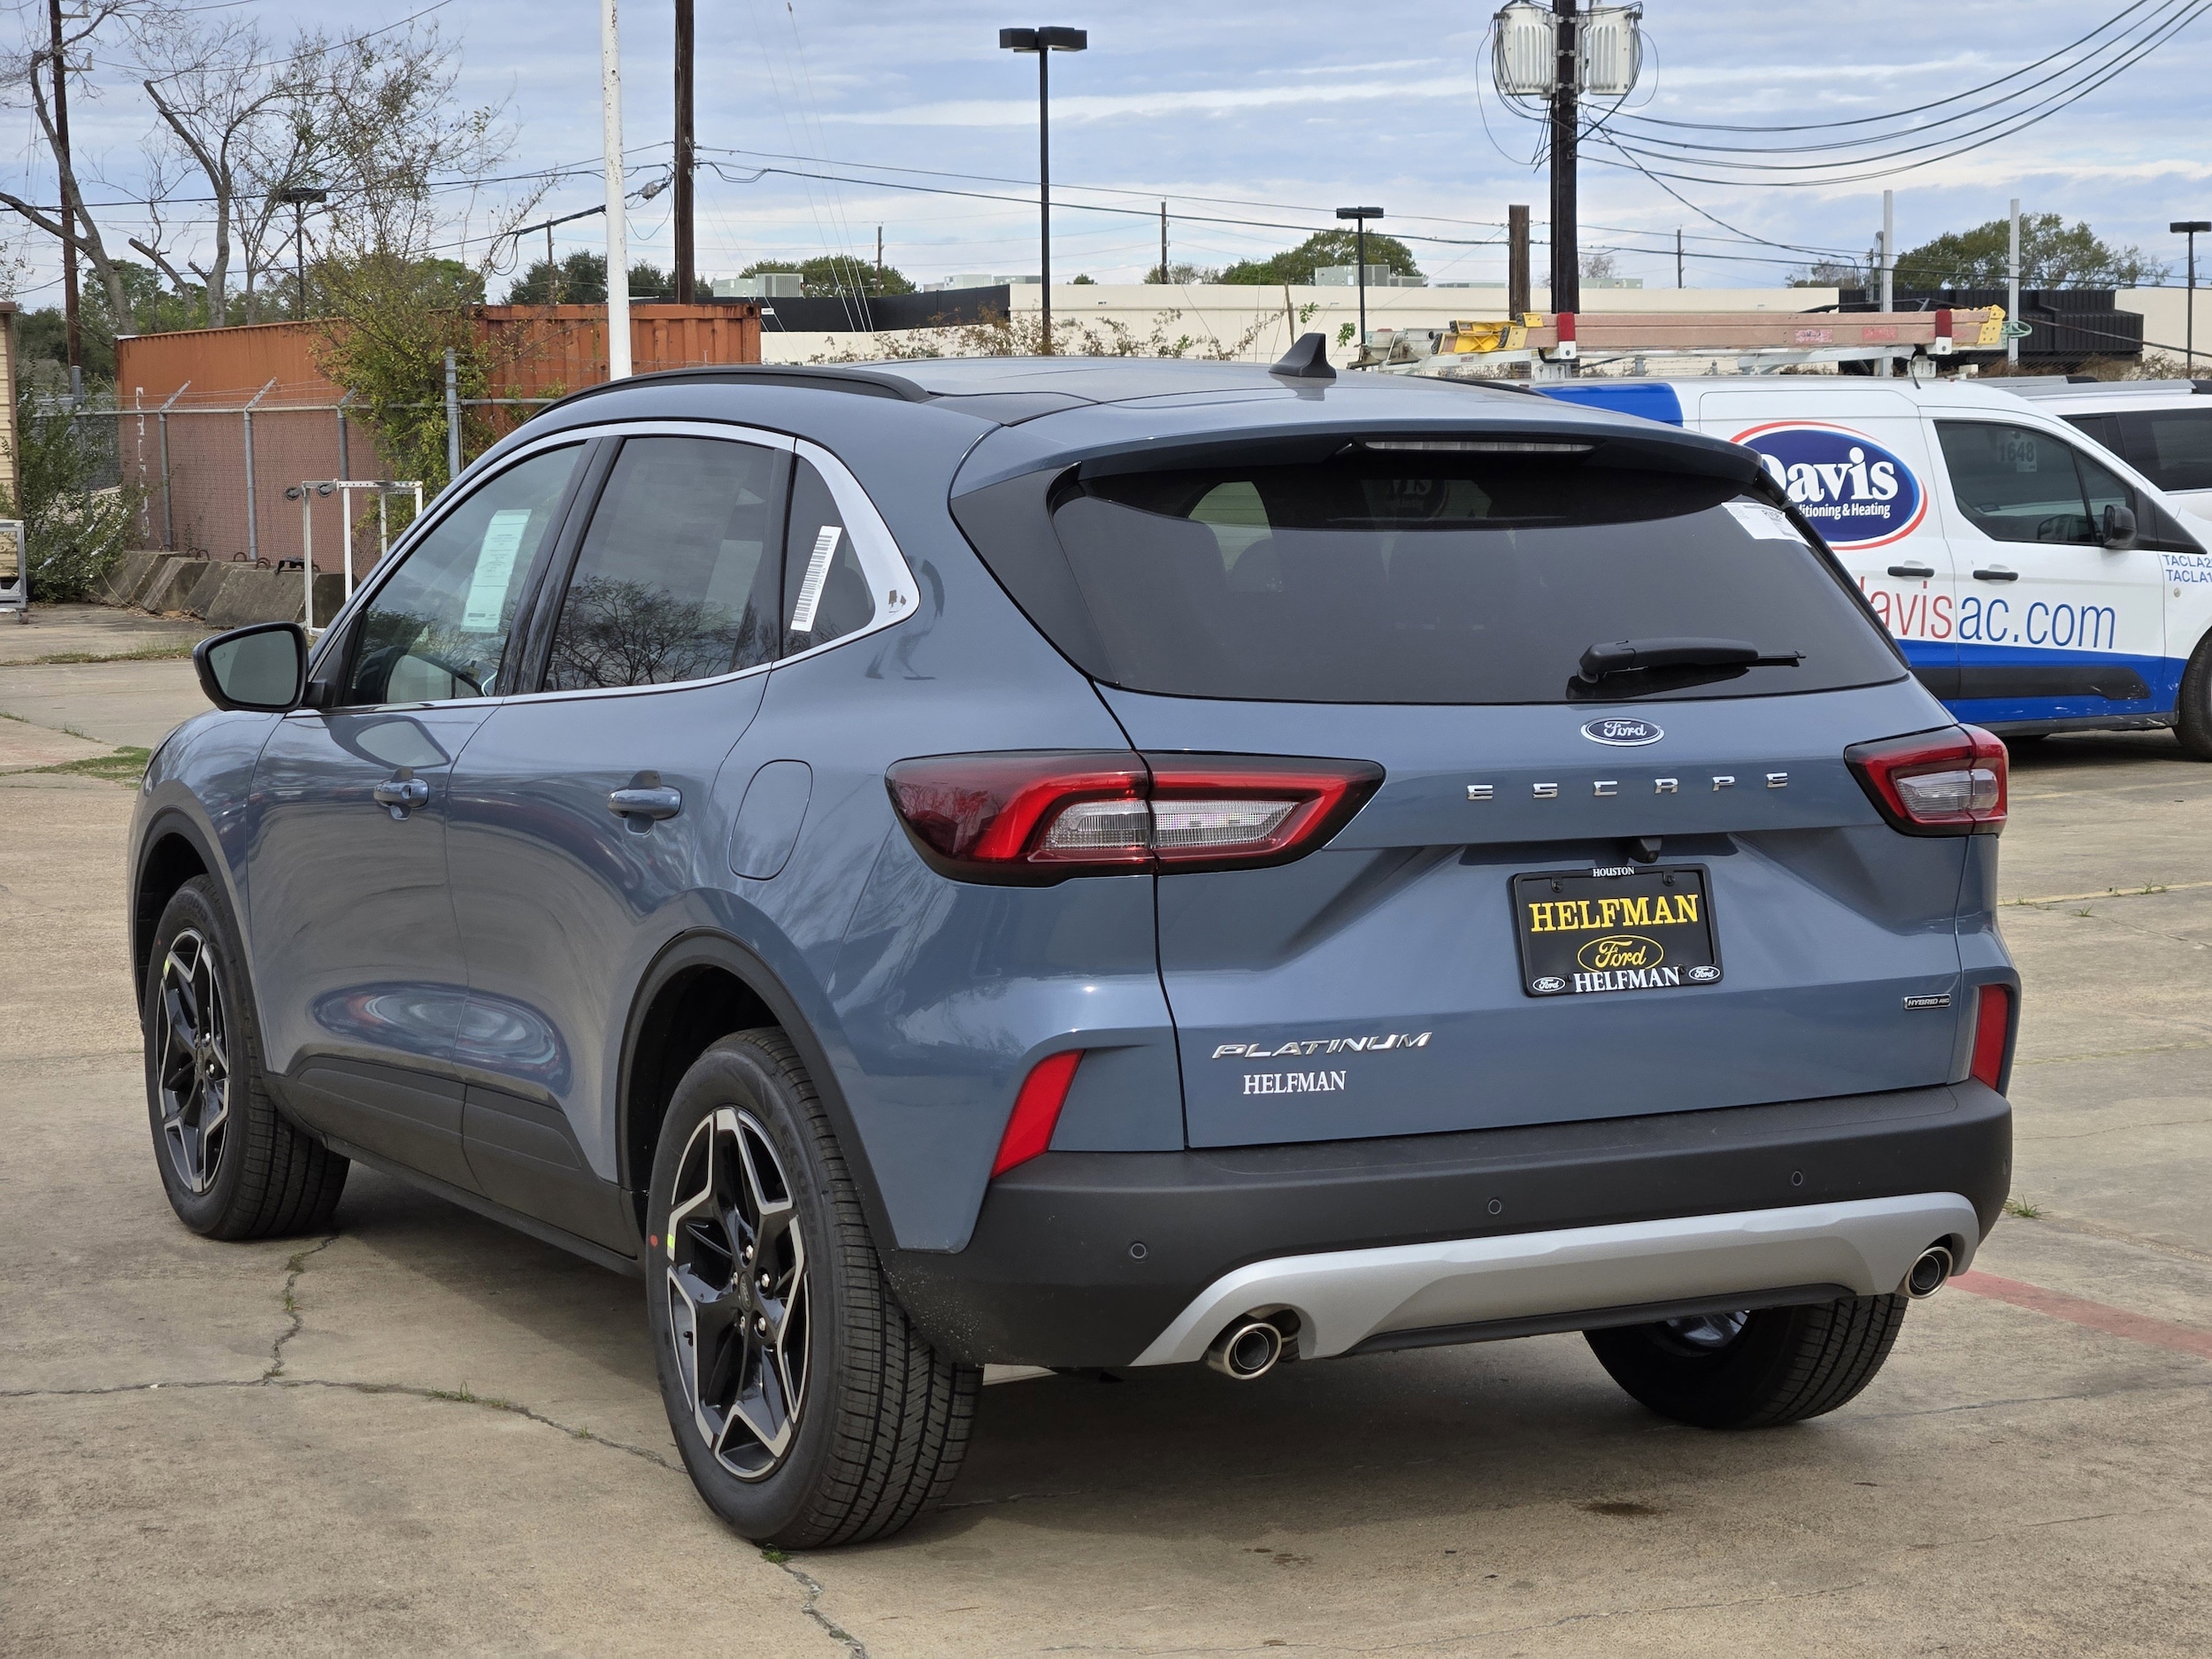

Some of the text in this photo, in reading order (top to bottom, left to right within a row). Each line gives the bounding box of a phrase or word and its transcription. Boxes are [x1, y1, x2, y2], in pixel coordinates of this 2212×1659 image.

[1842, 503, 1851, 516] &
[1851, 503, 1891, 518] Heating
[1859, 576, 2116, 649] avisac.com
[1603, 720, 1647, 737] Ford
[1467, 772, 1788, 800] ESCAPE
[1593, 866, 1635, 877] HOUSTON
[1528, 894, 1699, 933] HELFMAN
[1594, 940, 1647, 968] Ford
[1573, 966, 1680, 993] HELFMAN
[1212, 1032, 1432, 1058] PLATINUM
[1243, 1071, 1347, 1094] HELFMAN
